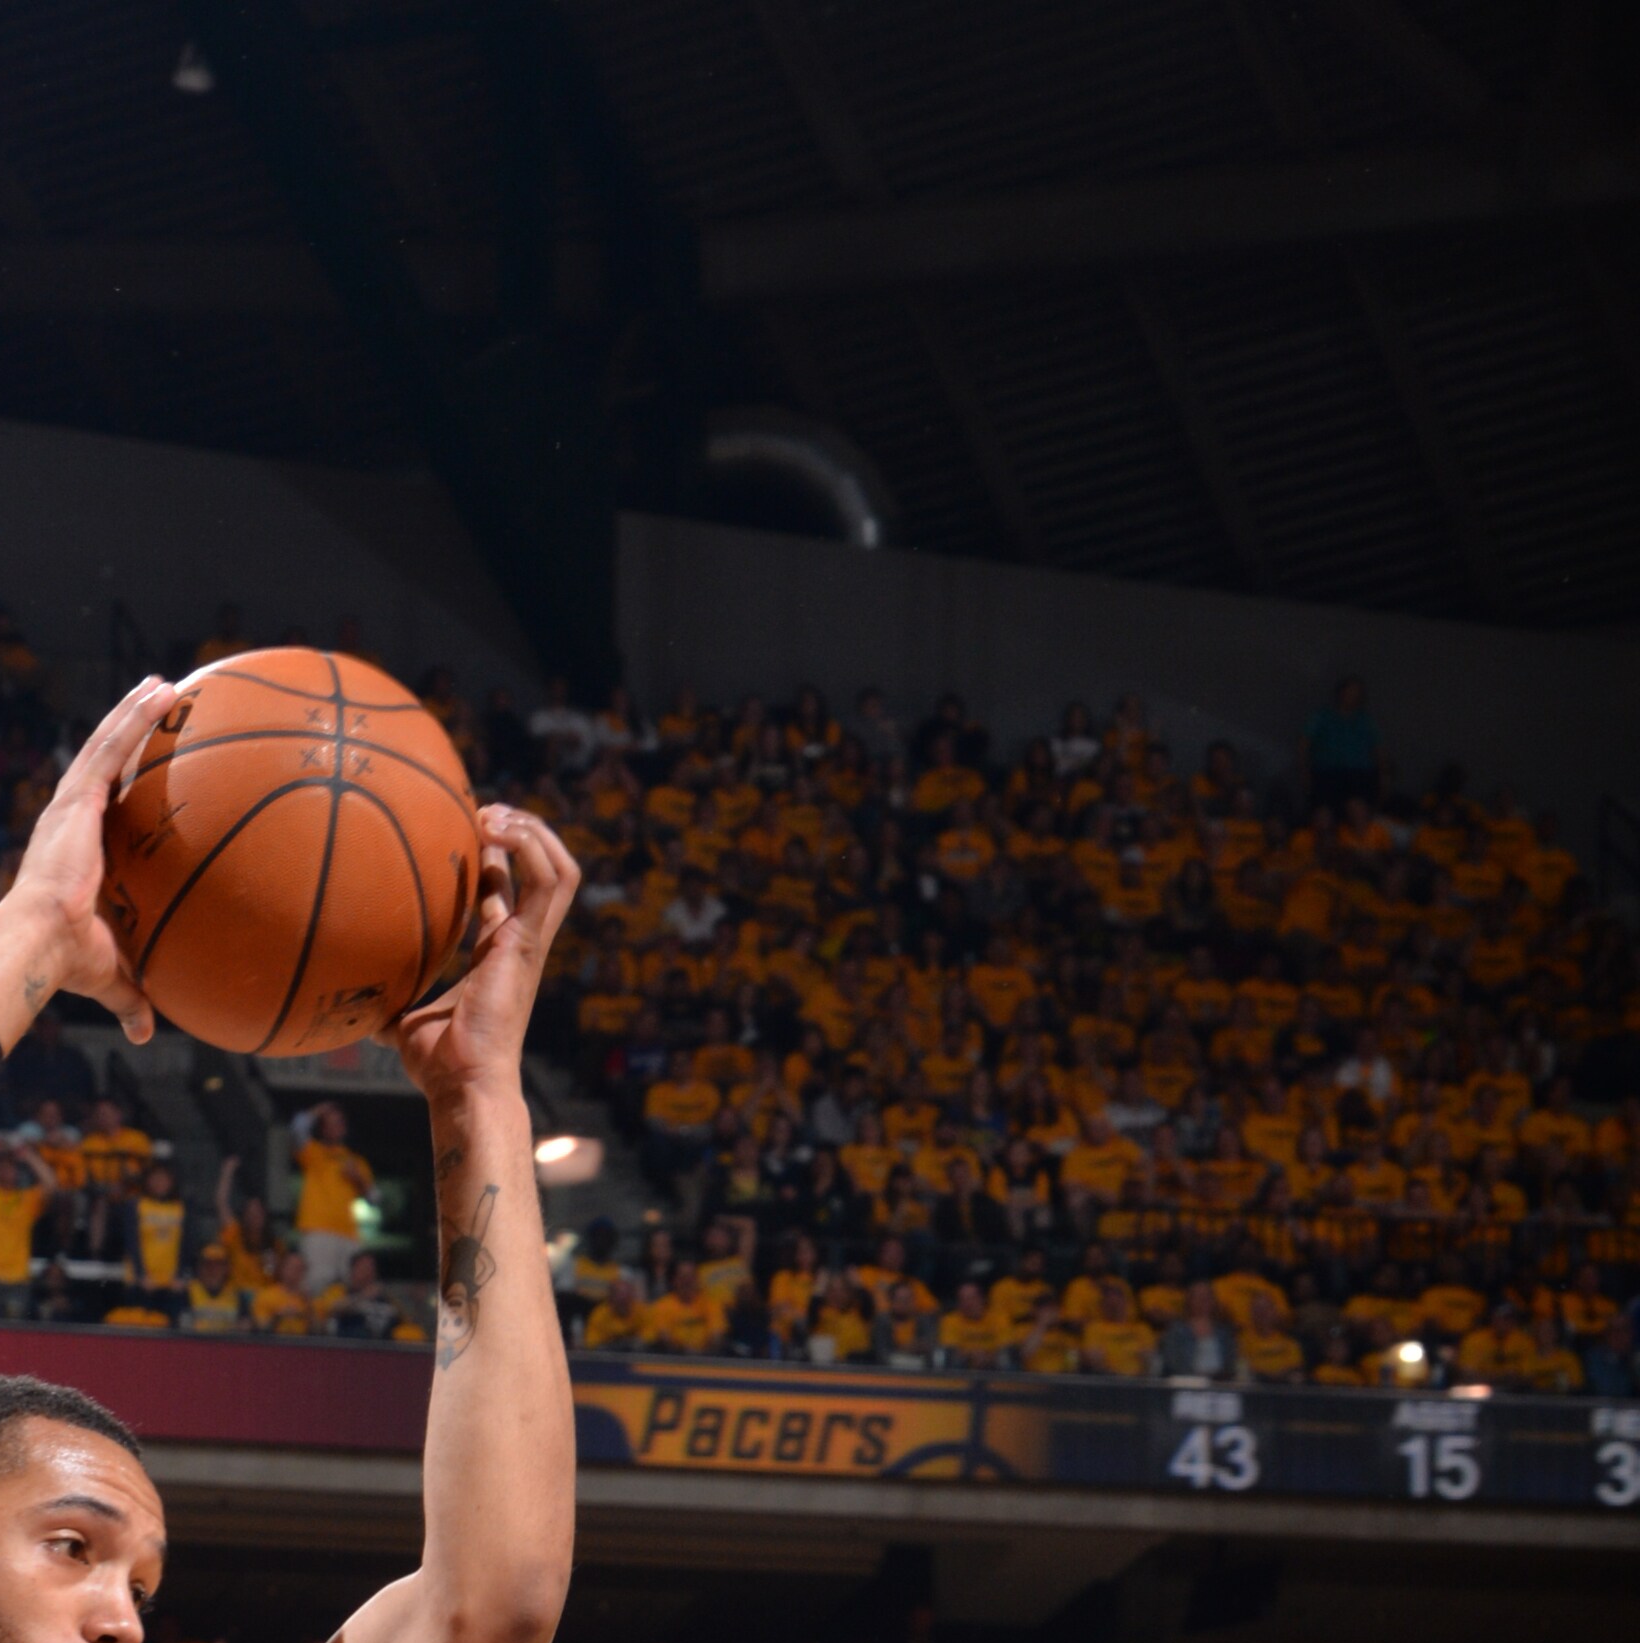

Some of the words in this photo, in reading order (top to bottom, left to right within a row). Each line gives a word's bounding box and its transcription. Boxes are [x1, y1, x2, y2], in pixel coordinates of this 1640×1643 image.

[639, 1385, 895, 1467] Pacers
[1168, 1425, 1260, 1492] 43
[1397, 1434, 1482, 1501] 15
